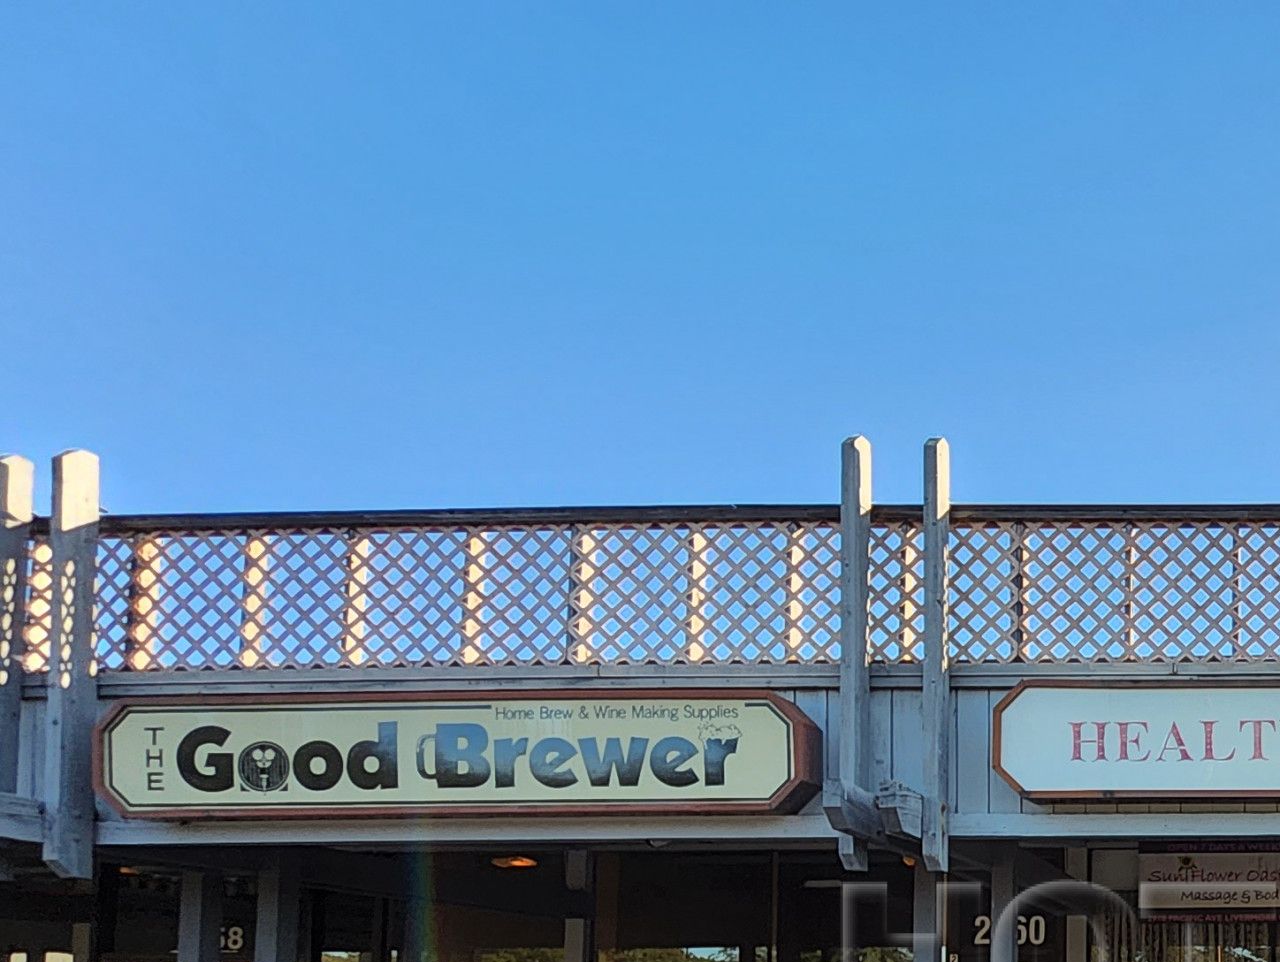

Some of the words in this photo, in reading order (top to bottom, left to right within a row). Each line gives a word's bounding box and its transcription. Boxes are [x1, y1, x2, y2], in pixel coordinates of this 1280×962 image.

[494, 705, 535, 720] Home
[539, 705, 573, 720] Brew
[578, 705, 590, 719] &
[593, 704, 627, 719] Wine
[631, 704, 680, 722] Making
[683, 703, 740, 722] Supplies
[143, 726, 165, 792] THE
[176, 720, 399, 796] Good
[433, 721, 740, 789] Brewer
[1180, 888, 1238, 904] Massage
[1240, 889, 1251, 902] &
